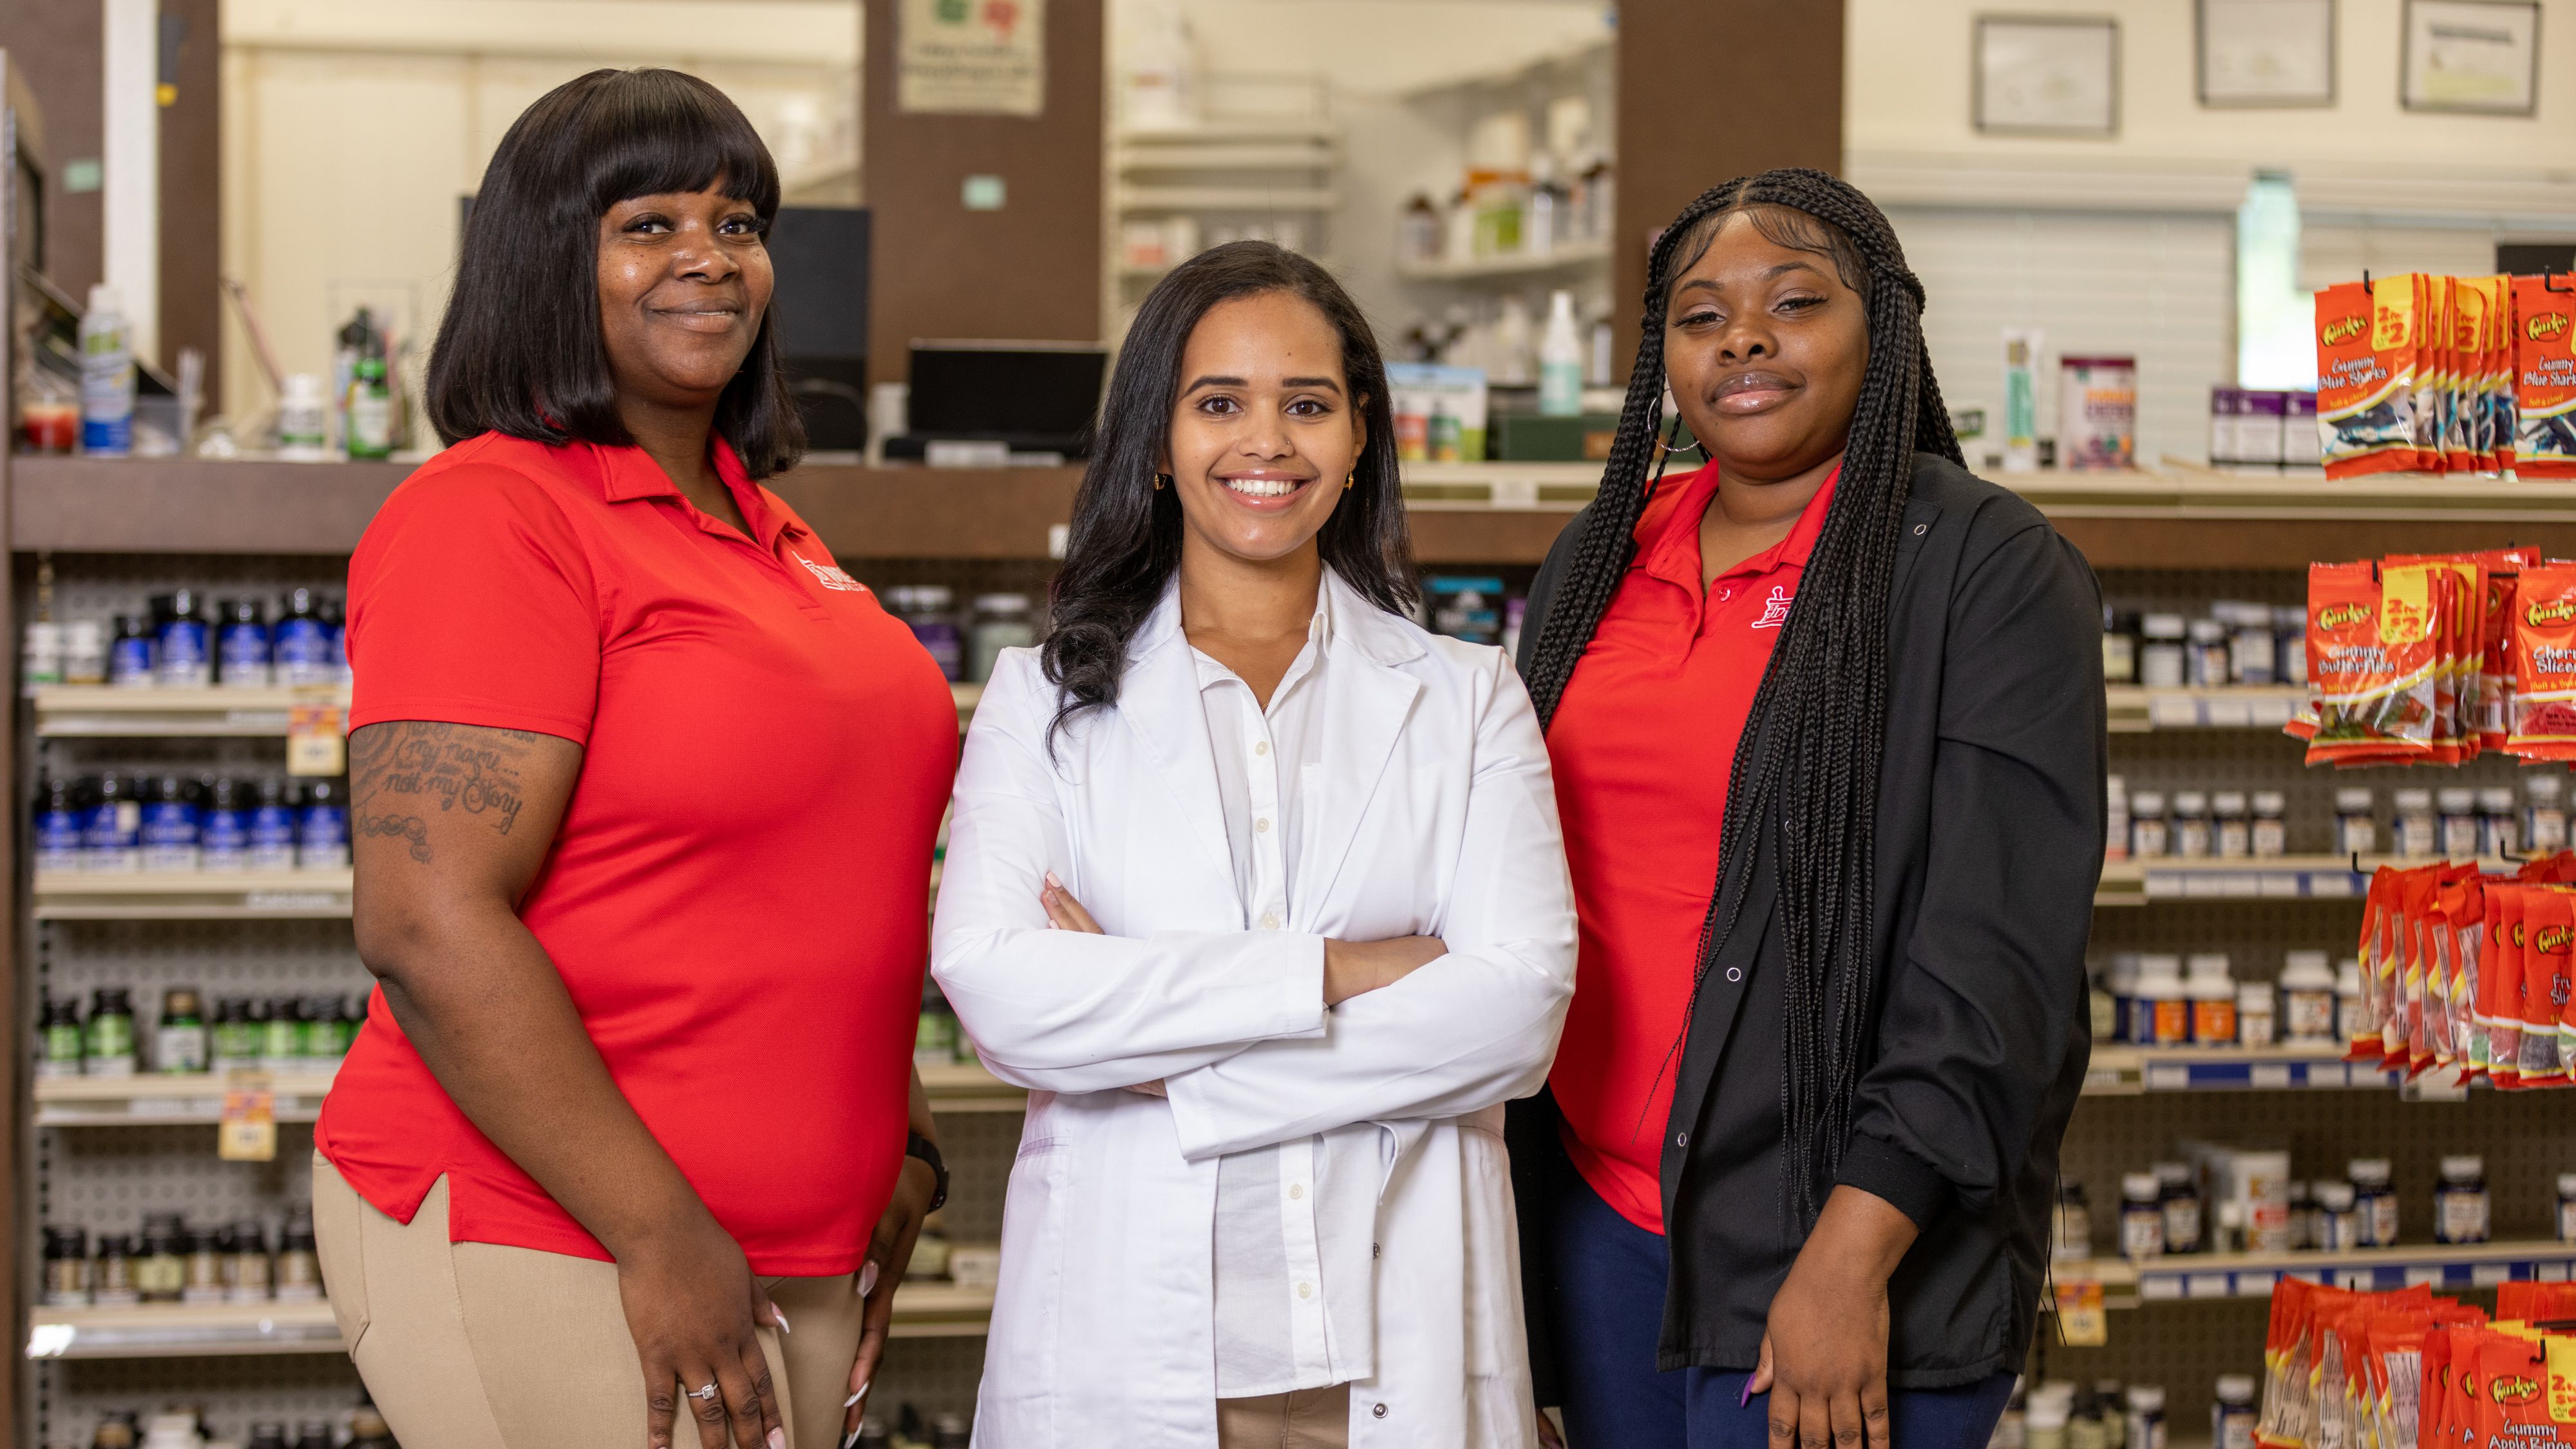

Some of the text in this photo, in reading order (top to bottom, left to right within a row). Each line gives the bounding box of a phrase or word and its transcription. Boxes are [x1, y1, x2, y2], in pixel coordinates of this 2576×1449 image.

[2539, 355, 2575, 377] Gummy
[2523, 370, 2576, 388] Blue Shark
[2532, 643, 2576, 660] Cher
[2536, 657, 2576, 675] Slice
[2552, 972, 2571, 994] Fru
[2503, 1417, 2558, 1443] Gummy
[2488, 1434, 2528, 1449] Apple
